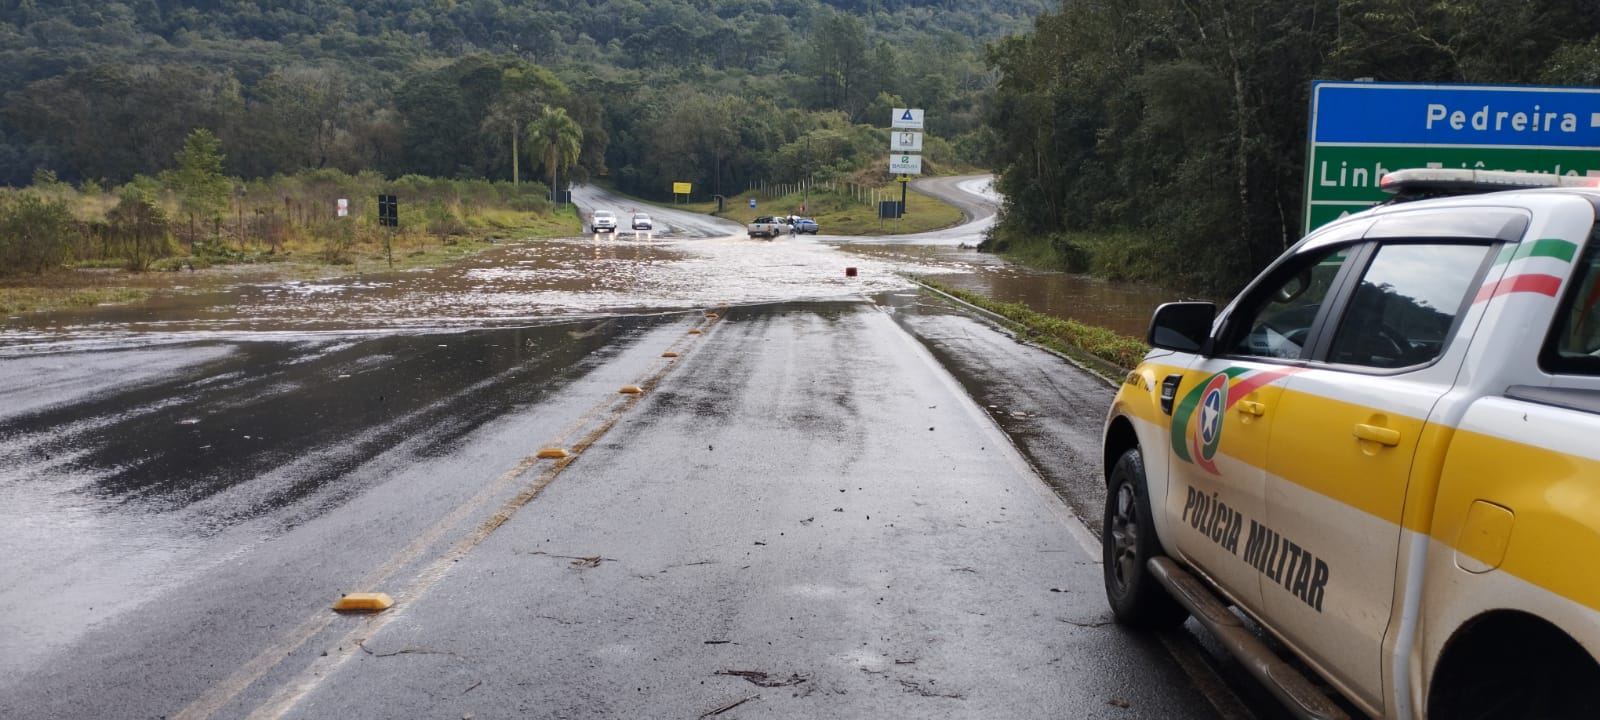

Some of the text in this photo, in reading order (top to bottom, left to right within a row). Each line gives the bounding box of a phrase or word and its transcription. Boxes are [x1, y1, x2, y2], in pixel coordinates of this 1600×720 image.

[1426, 103, 1577, 132] Pedreira
[1320, 161, 1391, 187] Linh
[1182, 485, 1329, 613] POLÍCIA MILITAR
